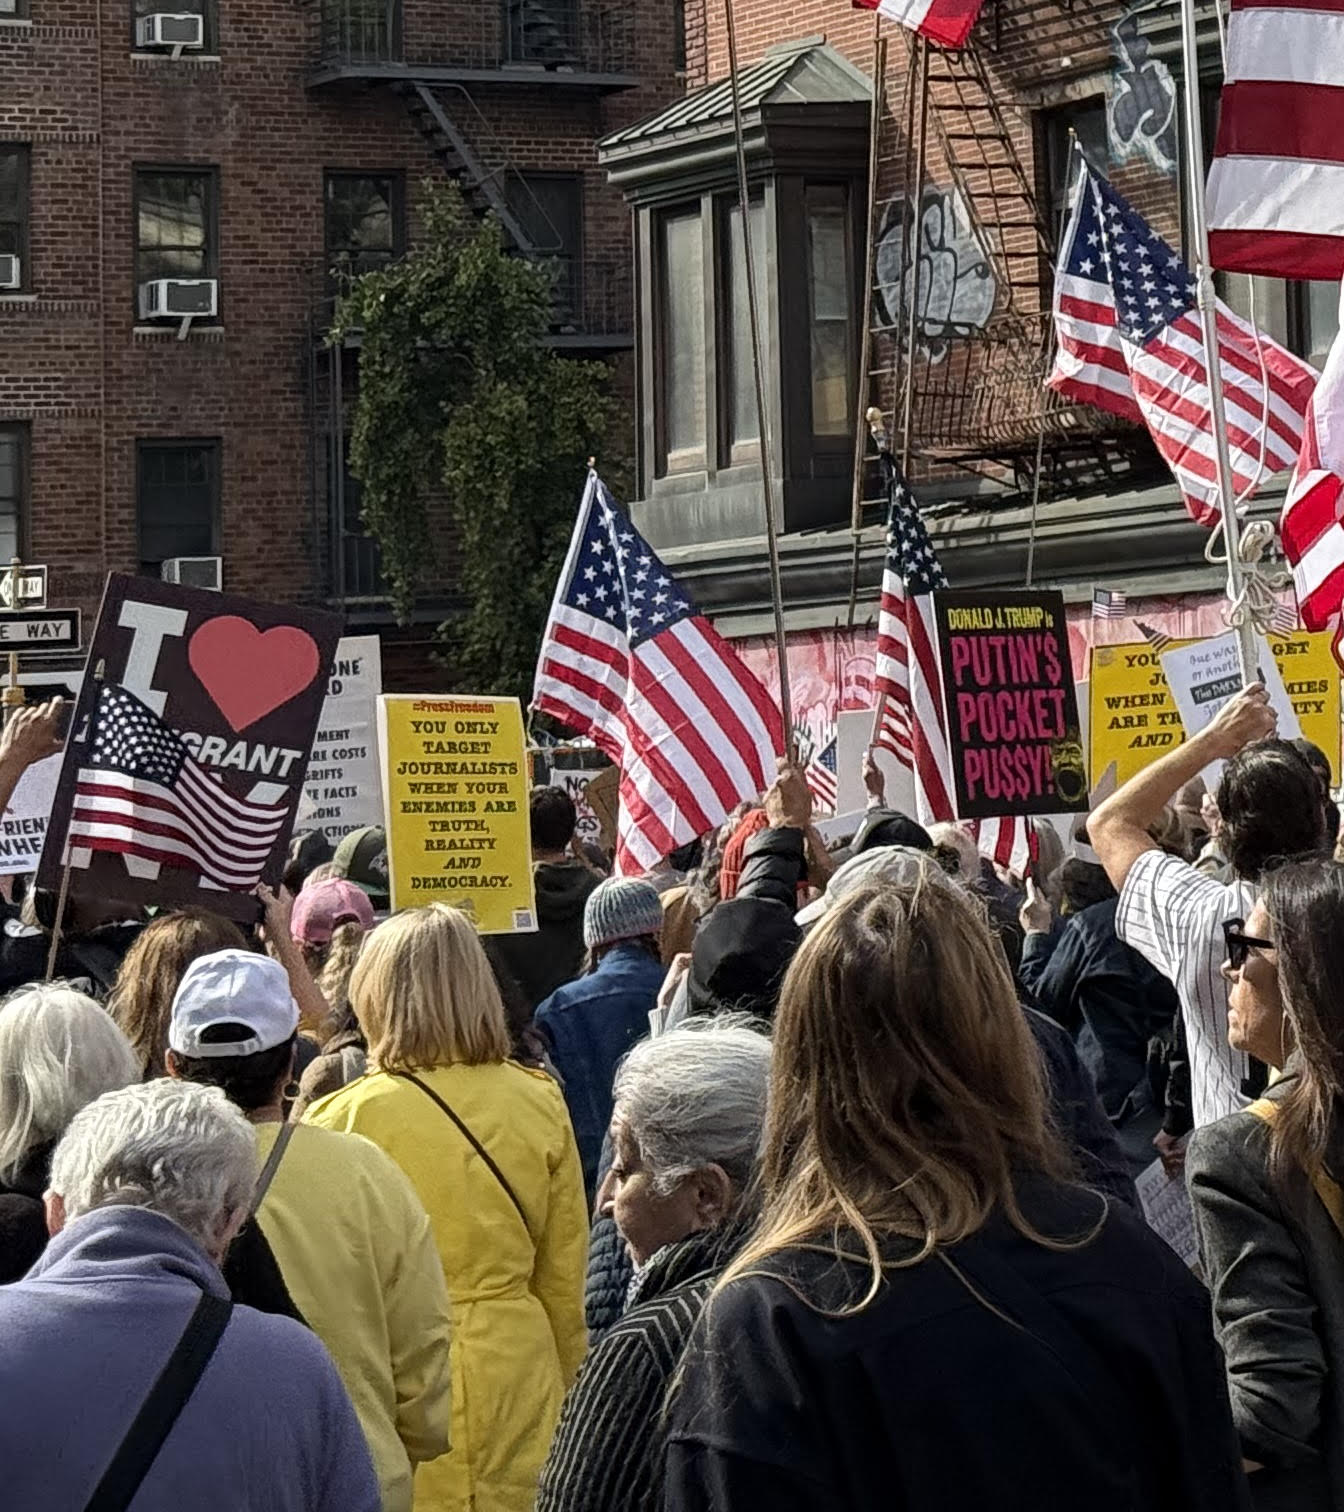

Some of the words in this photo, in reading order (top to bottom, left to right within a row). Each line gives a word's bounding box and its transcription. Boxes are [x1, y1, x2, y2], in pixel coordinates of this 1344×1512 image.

[948, 609, 993, 629] DONALD
[995, 607, 1005, 628] J.
[1004, 607, 1043, 628] TRUMP
[27, 623, 64, 638] WAY
[118, 599, 189, 719] I
[1105, 693, 1166, 709] WHEN
[957, 689, 1065, 742] POCKET
[1108, 715, 1148, 729] ARE
[411, 721, 446, 734] YOU
[455, 721, 499, 734] ONLY
[423, 741, 491, 754] TARGET
[1128, 735, 1173, 748] AND
[179, 732, 303, 778] GRANT
[332, 747, 366, 760] COSTS
[397, 762, 518, 775] JOURNALISTS
[324, 786, 357, 800] FACTS
[408, 782, 459, 794] WHEN
[464, 782, 509, 794] YOUR
[400, 801, 476, 813] ENEMIES
[484, 801, 516, 812] ARE
[429, 820, 490, 833] TRUTH,
[424, 838, 496, 851] REALITY
[443, 857, 481, 869] AND
[411, 876, 512, 889] DEMOCRACY.
